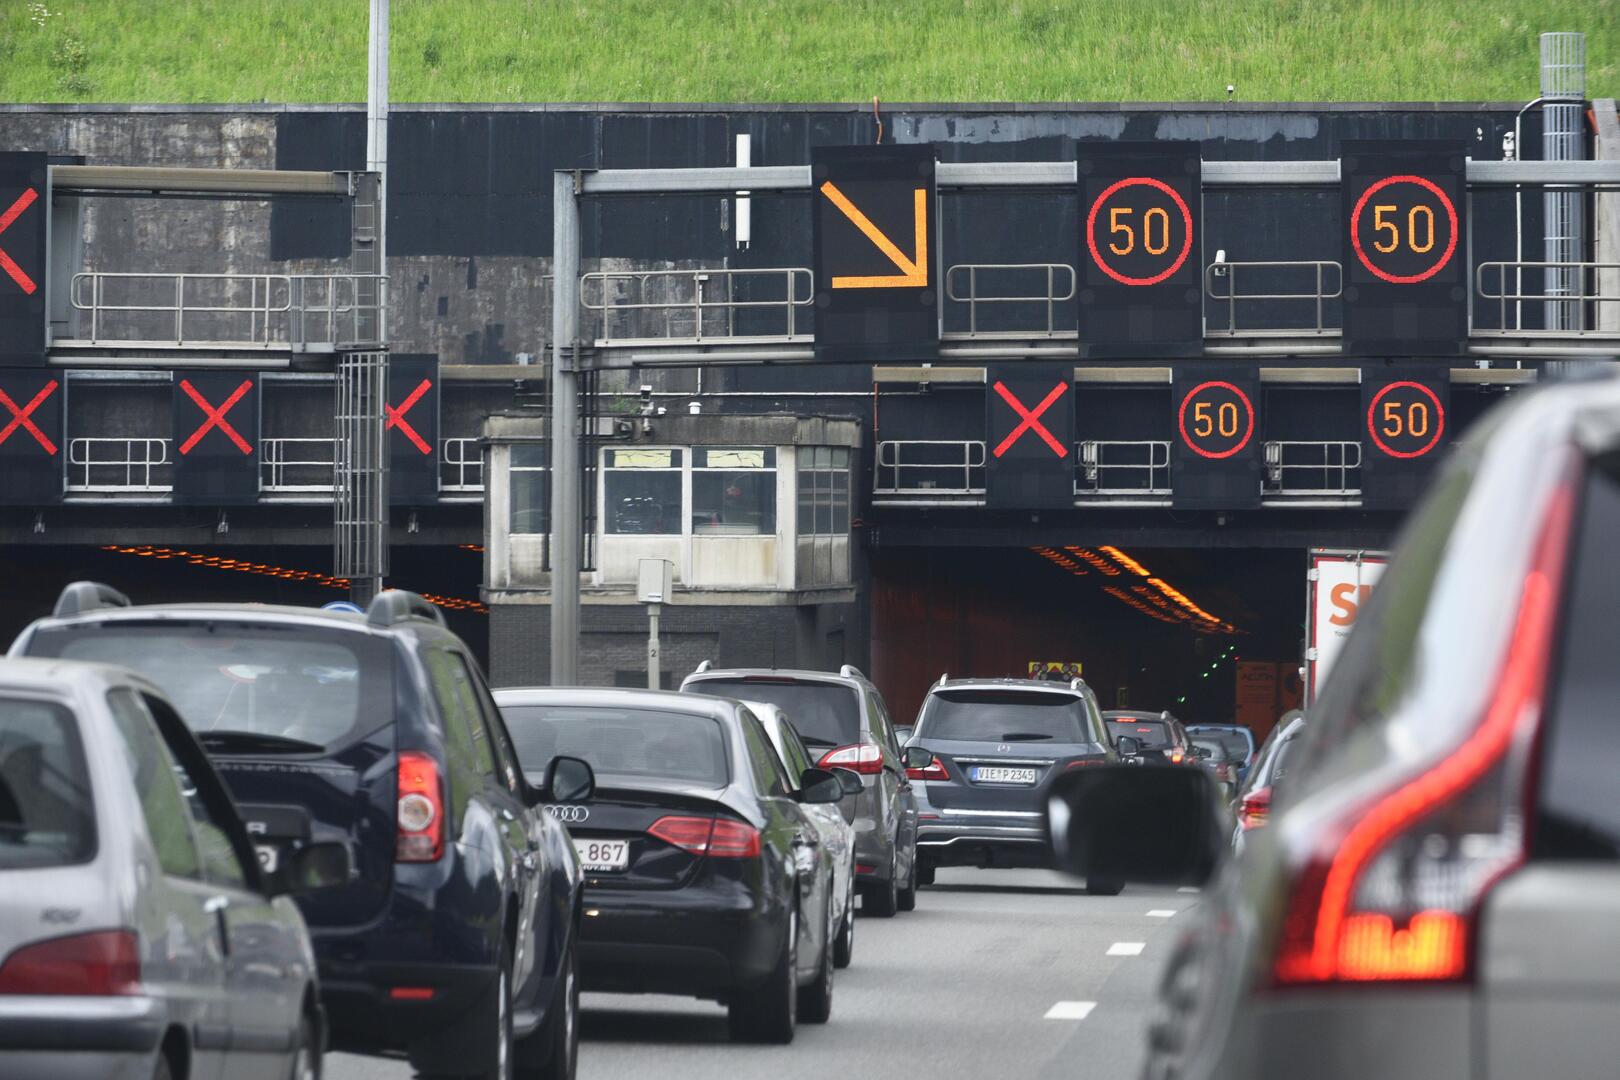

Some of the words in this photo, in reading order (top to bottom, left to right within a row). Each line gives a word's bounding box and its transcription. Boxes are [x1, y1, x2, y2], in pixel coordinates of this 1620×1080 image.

[1109, 207, 1169, 255] 50
[1374, 205, 1434, 253] 50
[1194, 402, 1238, 437] 50
[1382, 402, 1428, 437] 50
[650, 649, 657, 657] 2
[979, 768, 996, 779] VIE
